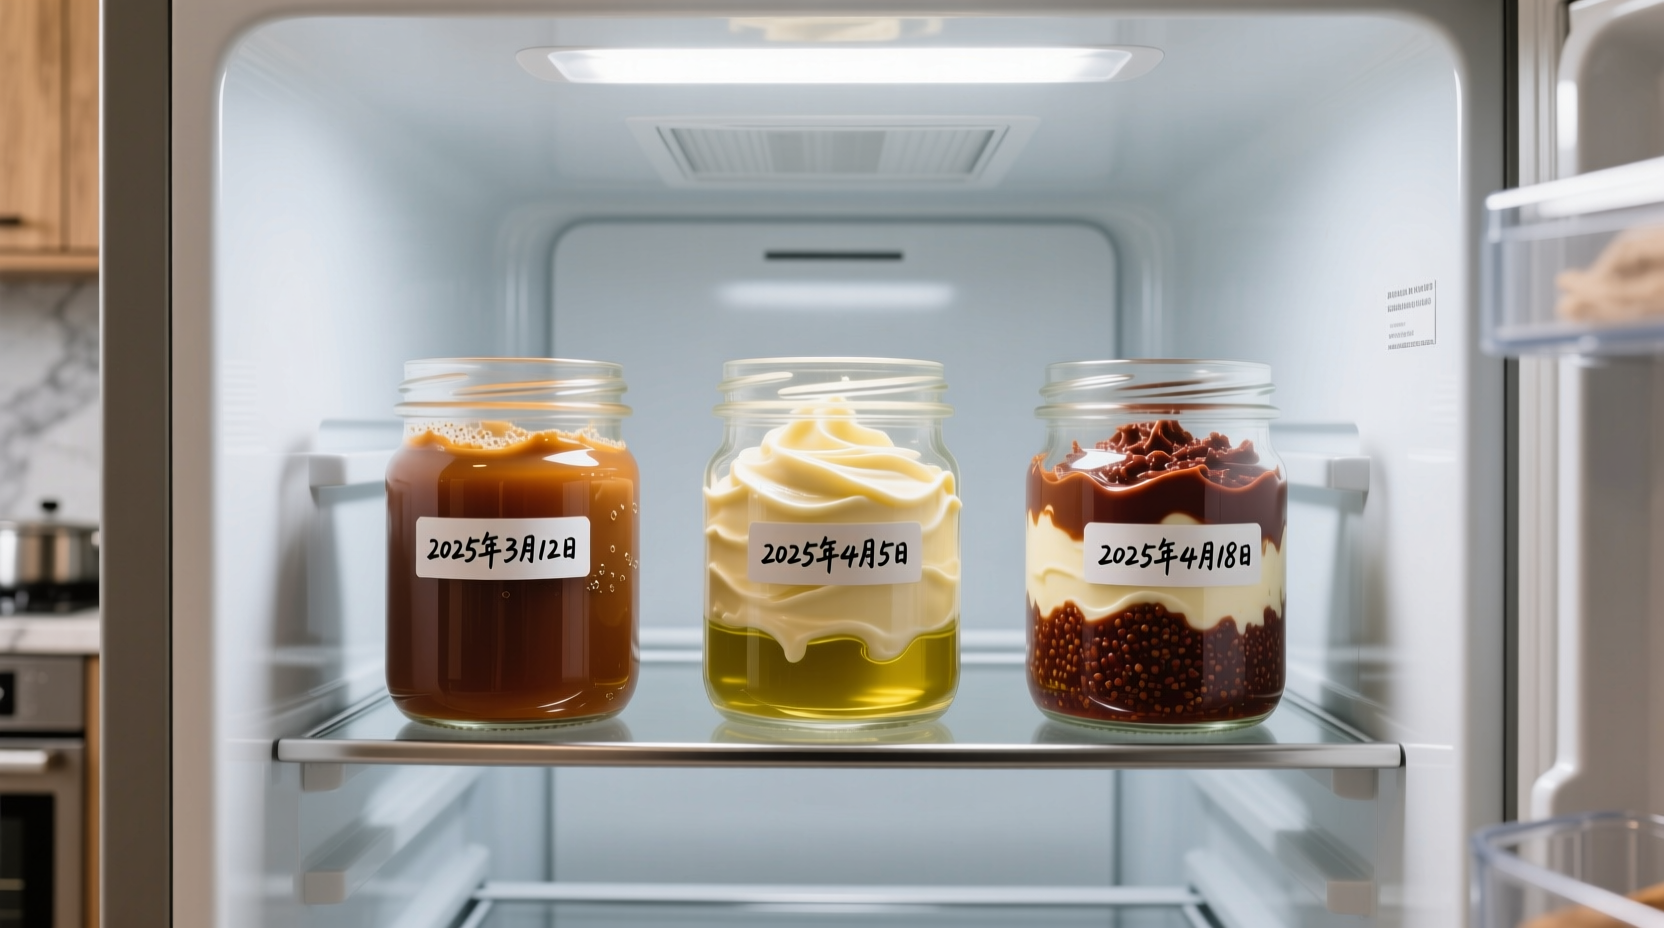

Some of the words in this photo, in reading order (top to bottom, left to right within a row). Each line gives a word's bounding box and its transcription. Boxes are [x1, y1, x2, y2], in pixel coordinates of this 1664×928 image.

[427, 531, 576, 570] 2025年3月12日
[761, 535, 908, 575] 2025年4月5日
[1098, 537, 1251, 576] 2025年4月18日
